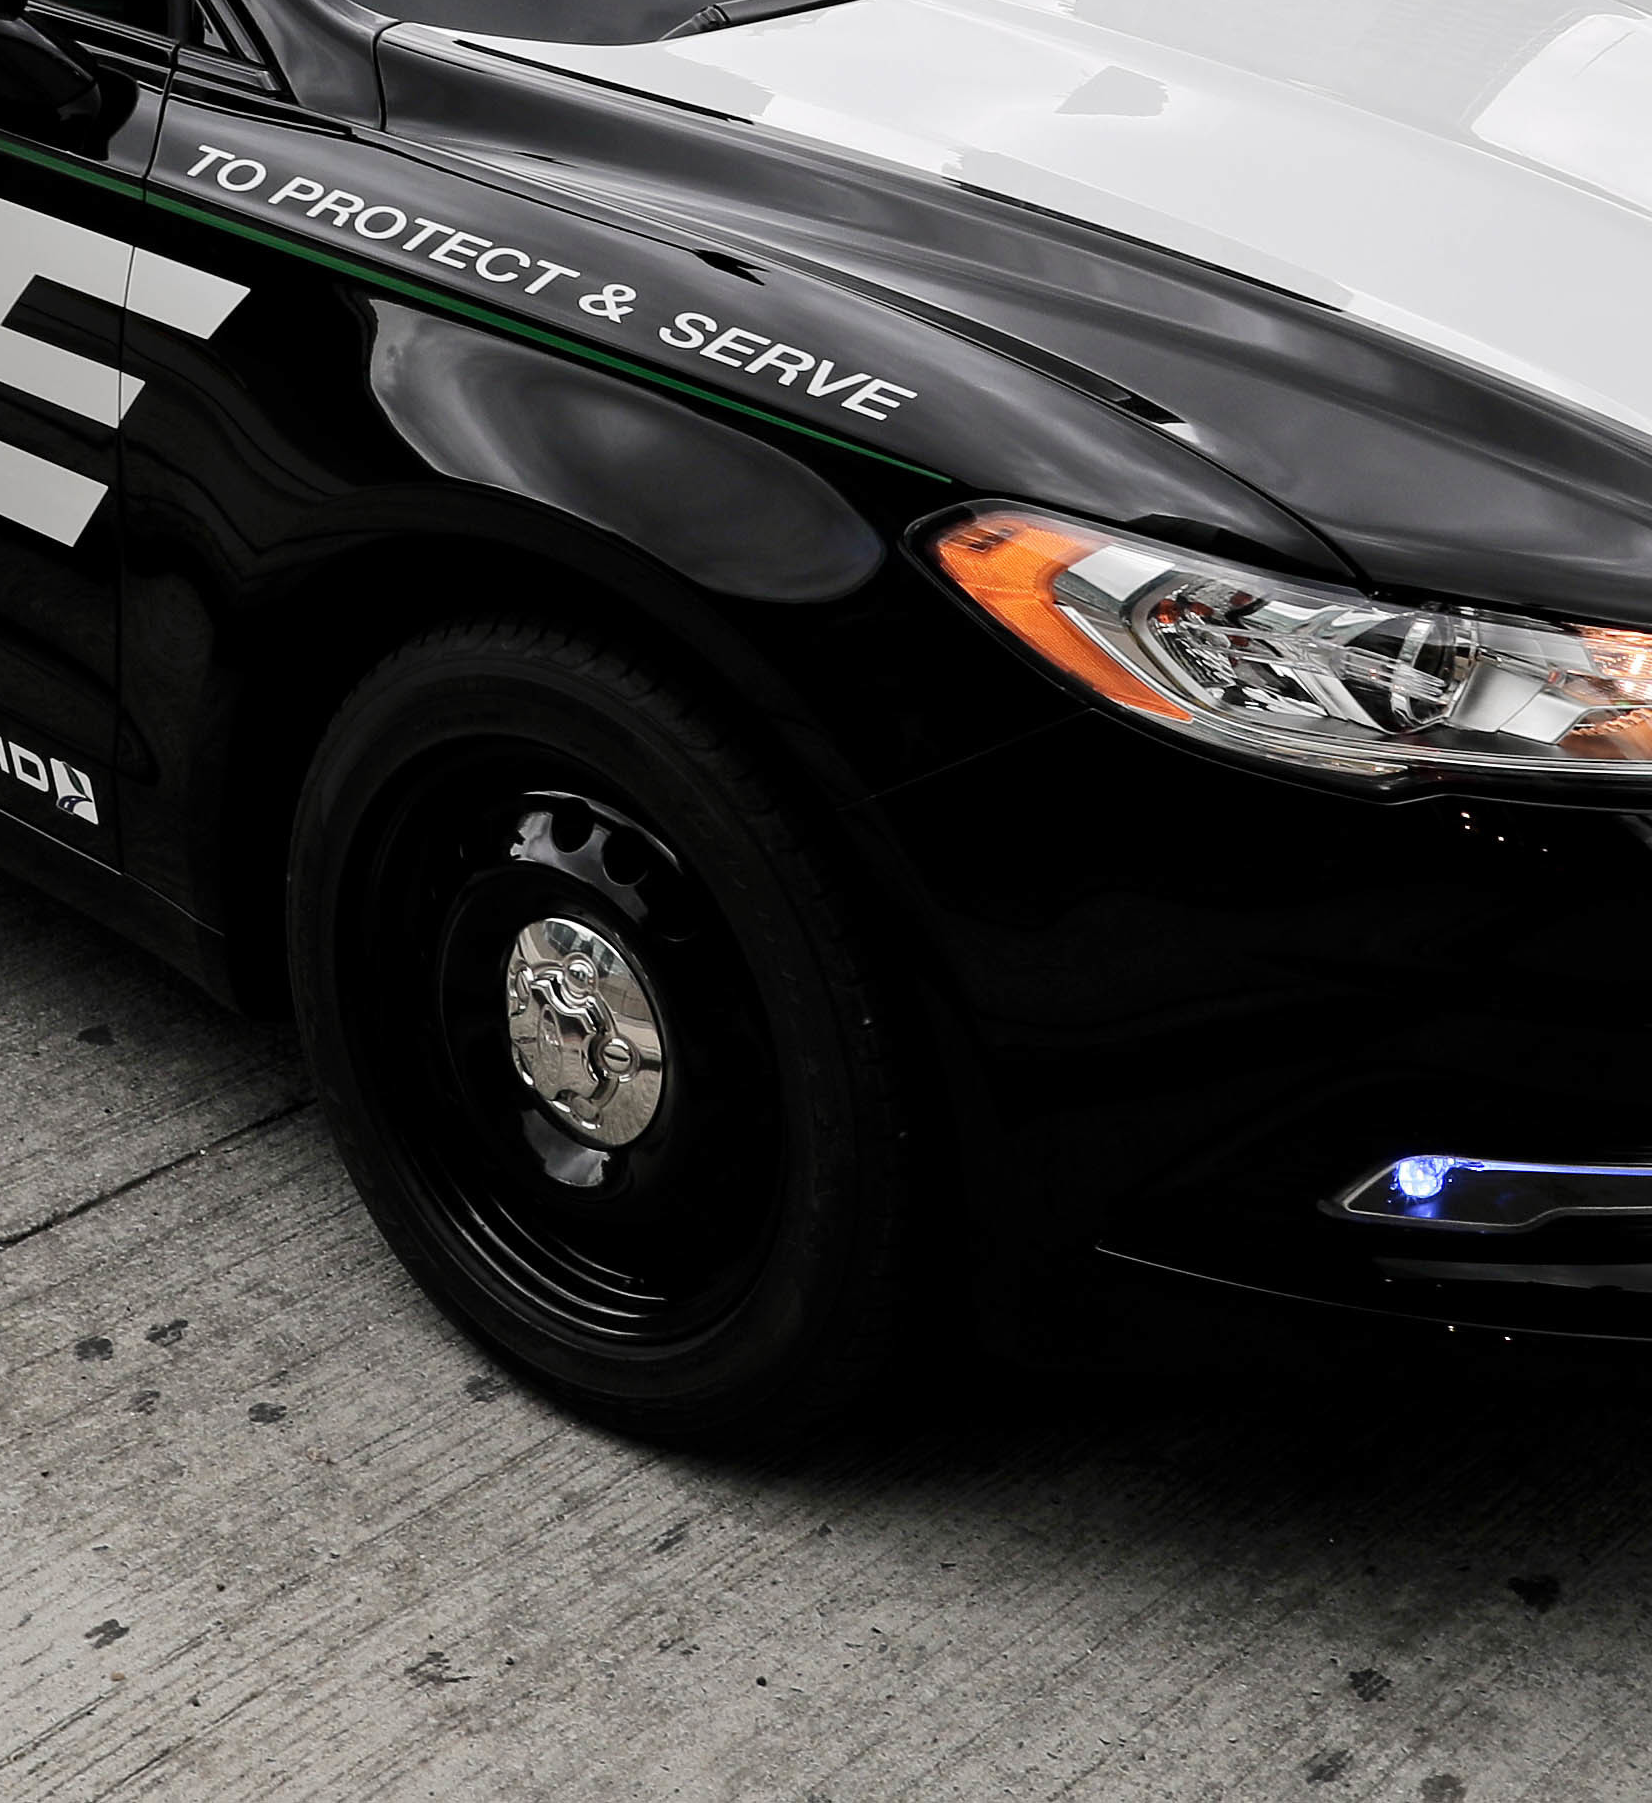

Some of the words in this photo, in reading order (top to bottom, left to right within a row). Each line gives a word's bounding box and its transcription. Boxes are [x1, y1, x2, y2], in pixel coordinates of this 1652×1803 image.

[187, 145, 267, 192] TO
[268, 176, 581, 295] PROTECT
[577, 284, 639, 325] &
[658, 311, 918, 422] SERVE
